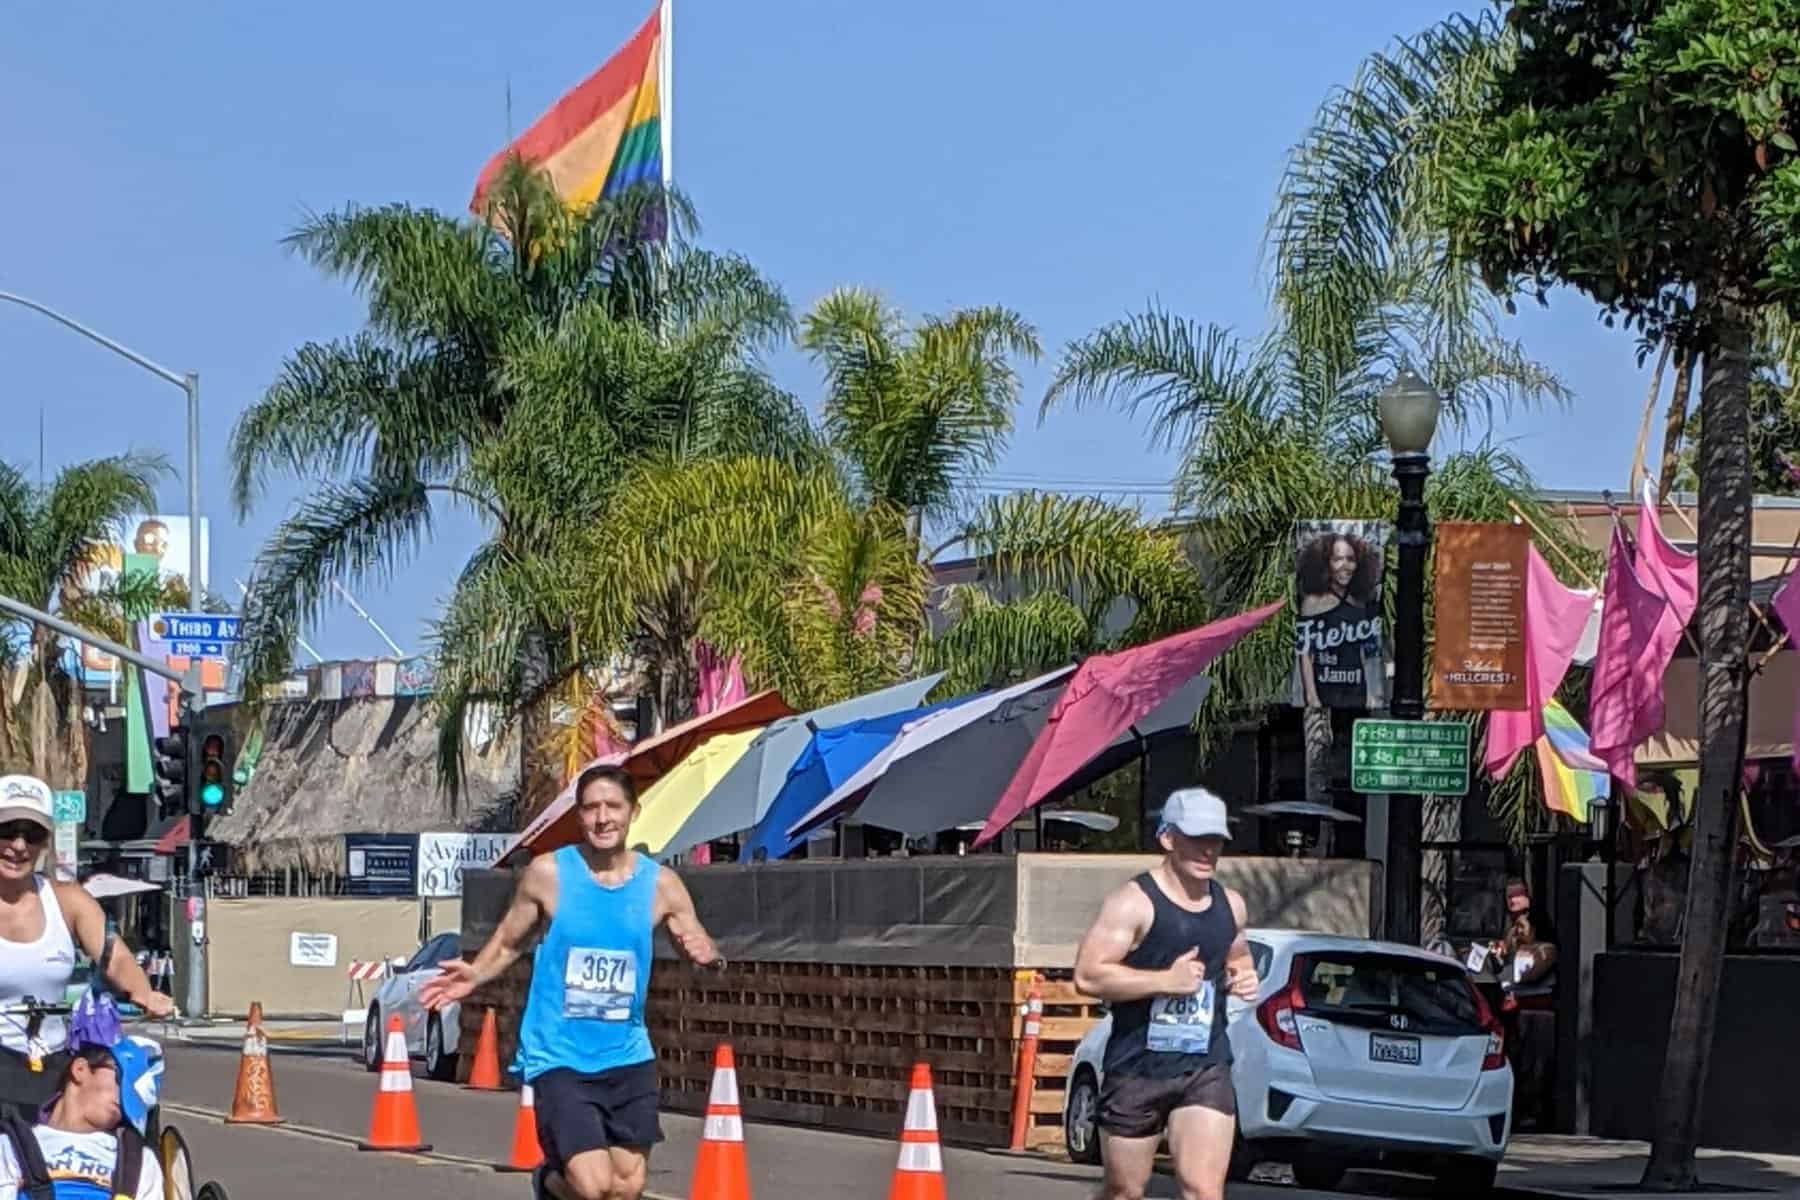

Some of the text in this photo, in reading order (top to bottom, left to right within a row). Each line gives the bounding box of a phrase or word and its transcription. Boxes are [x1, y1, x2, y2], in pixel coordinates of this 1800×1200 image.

[1296, 616, 1383, 656] Fierce
[1449, 672, 1511, 683] HILLCREST
[425, 838, 508, 863] Availabl
[582, 954, 628, 984] 3671
